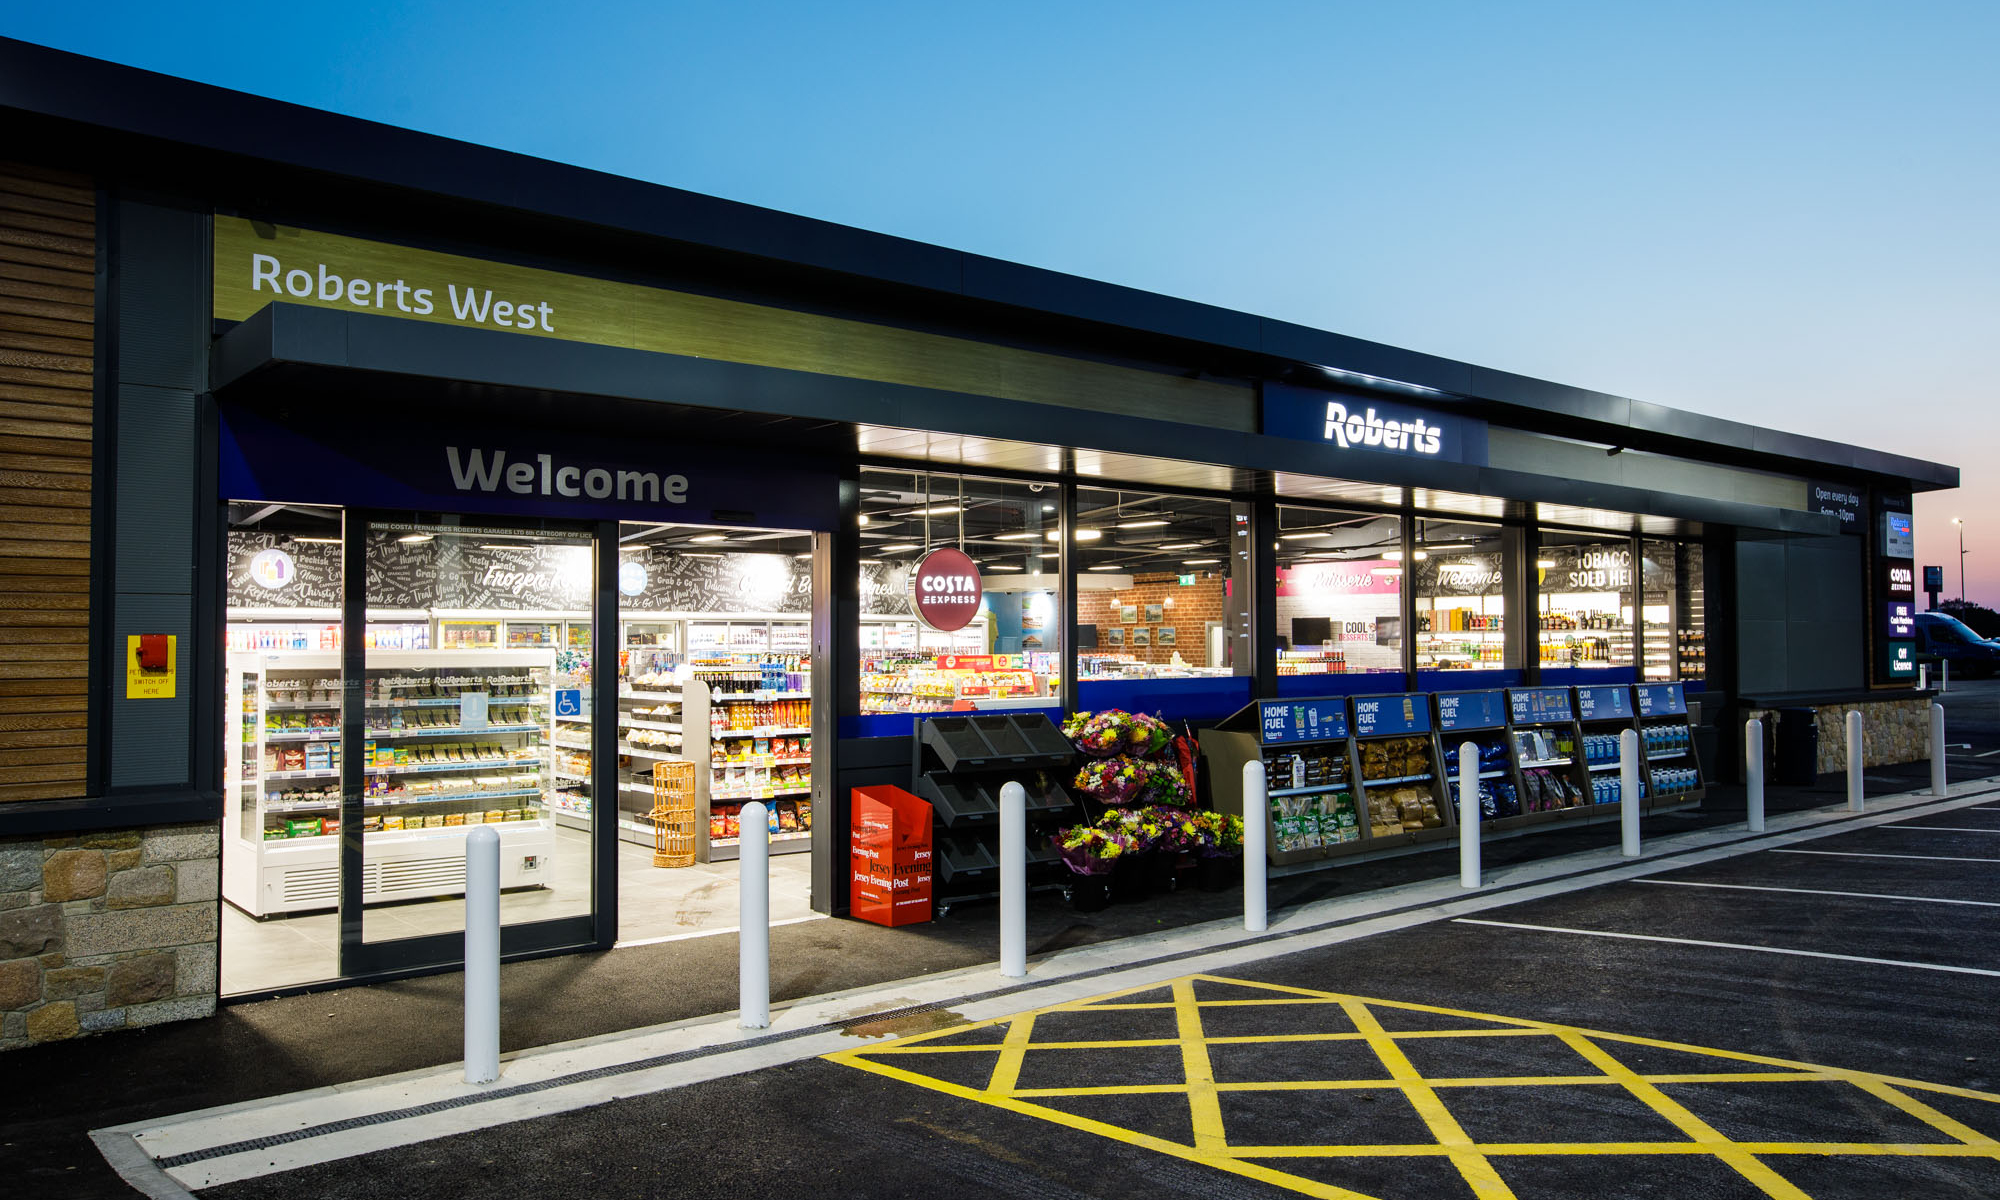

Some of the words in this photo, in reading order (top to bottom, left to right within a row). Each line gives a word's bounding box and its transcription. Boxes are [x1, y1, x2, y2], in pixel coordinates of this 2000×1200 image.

[251, 253, 434, 315] Roberts
[448, 284, 554, 333] West
[1324, 401, 1441, 454] Roberts
[446, 446, 689, 504] Welcome
[1816, 486, 1831, 501] Open
[1832, 492, 1848, 505] every
[1848, 492, 1859, 506] day
[1839, 508, 1854, 523] 10pm
[300, 554, 328, 565] Peckish
[1577, 551, 1631, 569] OBACC
[416, 569, 436, 578] Grab
[1437, 569, 1502, 586] Welcome
[1891, 568, 1911, 583] COSTA
[657, 577, 674, 585] Grab
[922, 575, 976, 594] COSTA
[1569, 571, 1606, 588] SOLD
[244, 584, 298, 608] Refreshing
[410, 586, 432, 603] Treat
[436, 578, 470, 600] Yourself
[397, 593, 410, 604] Go
[931, 595, 976, 604] EXPRESS
[500, 599, 520, 610] Tasty
[1896, 606, 1907, 616] FREE
[1346, 622, 1367, 633] COOL
[1898, 648, 1907, 659] Off
[1894, 660, 1912, 671] Licence
[1512, 693, 1529, 702] HOME
[1580, 691, 1590, 699] CAR
[1639, 689, 1648, 697] CAR
[1357, 702, 1379, 713] HOME
[1440, 698, 1459, 707] HOME
[1513, 703, 1527, 712] FUEL
[1640, 698, 1652, 706] CARE
[1264, 706, 1288, 717] HOME
[1441, 708, 1456, 718] FUEL
[1265, 718, 1285, 729] FUEL
[1358, 714, 1376, 724] FUEL
[853, 846, 870, 858] Evening
[870, 849, 879, 859] Post
[914, 851, 931, 860] Jersey
[870, 859, 890, 877] Jersey
[894, 861, 931, 875] Evening
[854, 870, 870, 885] Jersey
[870, 875, 892, 891] Evening
[893, 878, 909, 888] Post
